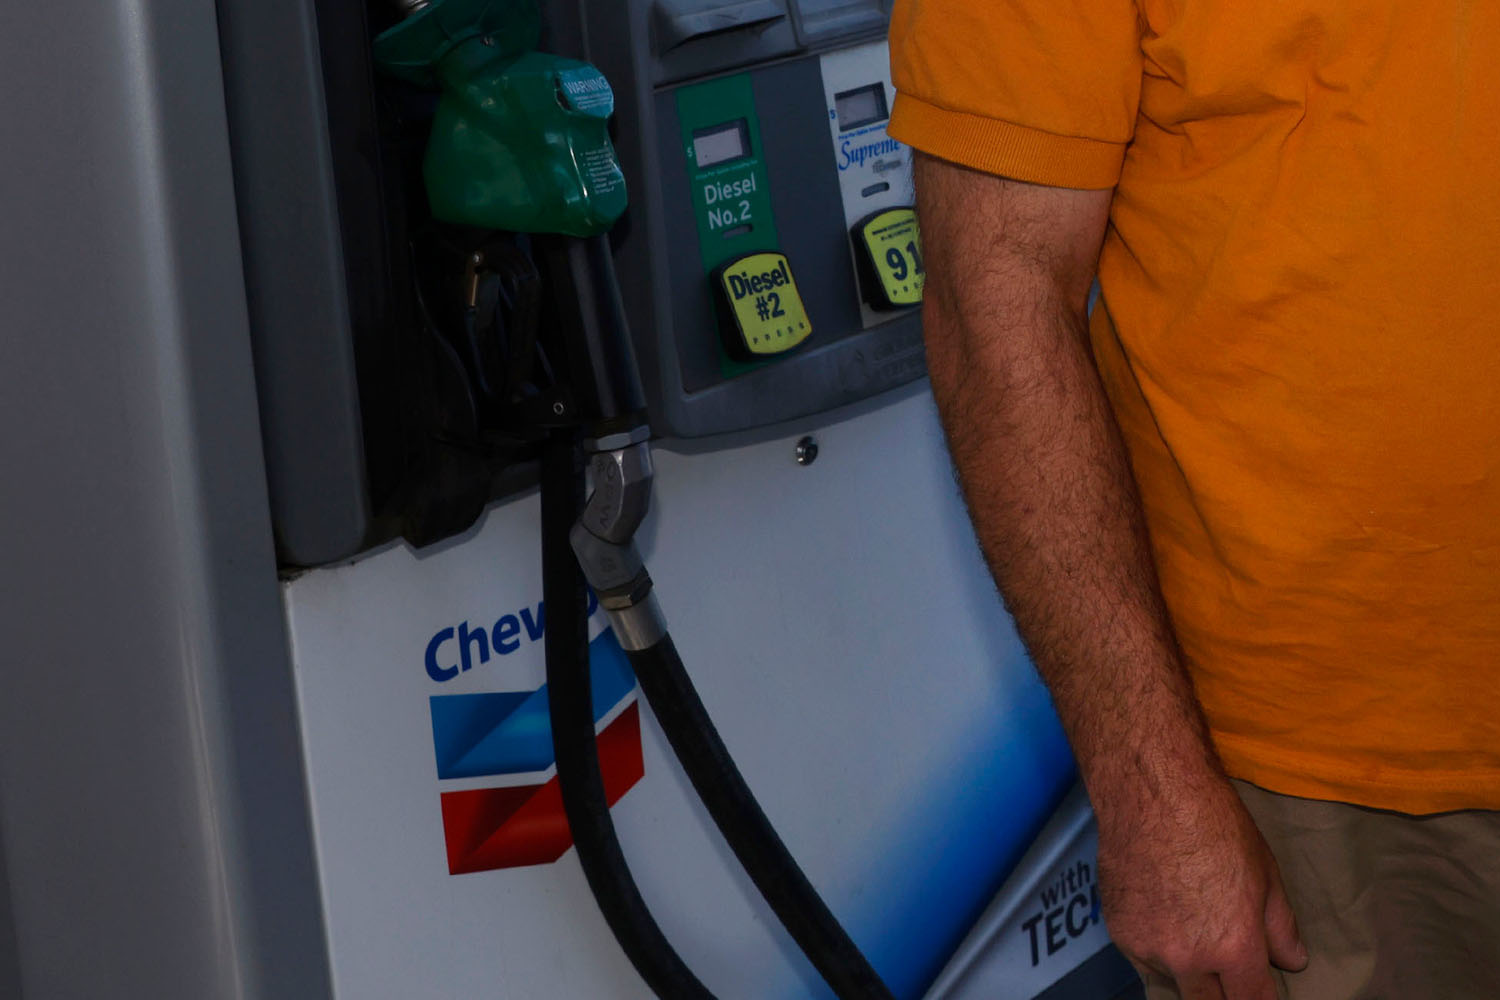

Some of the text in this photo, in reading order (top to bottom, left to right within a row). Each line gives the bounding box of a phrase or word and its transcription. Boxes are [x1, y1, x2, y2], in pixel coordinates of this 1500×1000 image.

[564, 76, 609, 94] WARNING
[704, 172, 756, 204] Diesel
[708, 200, 752, 229] No. 2
[886, 240, 924, 280] 91
[728, 260, 791, 301] Diesel
[756, 292, 785, 322] #2
[1041, 861, 1090, 911] with
